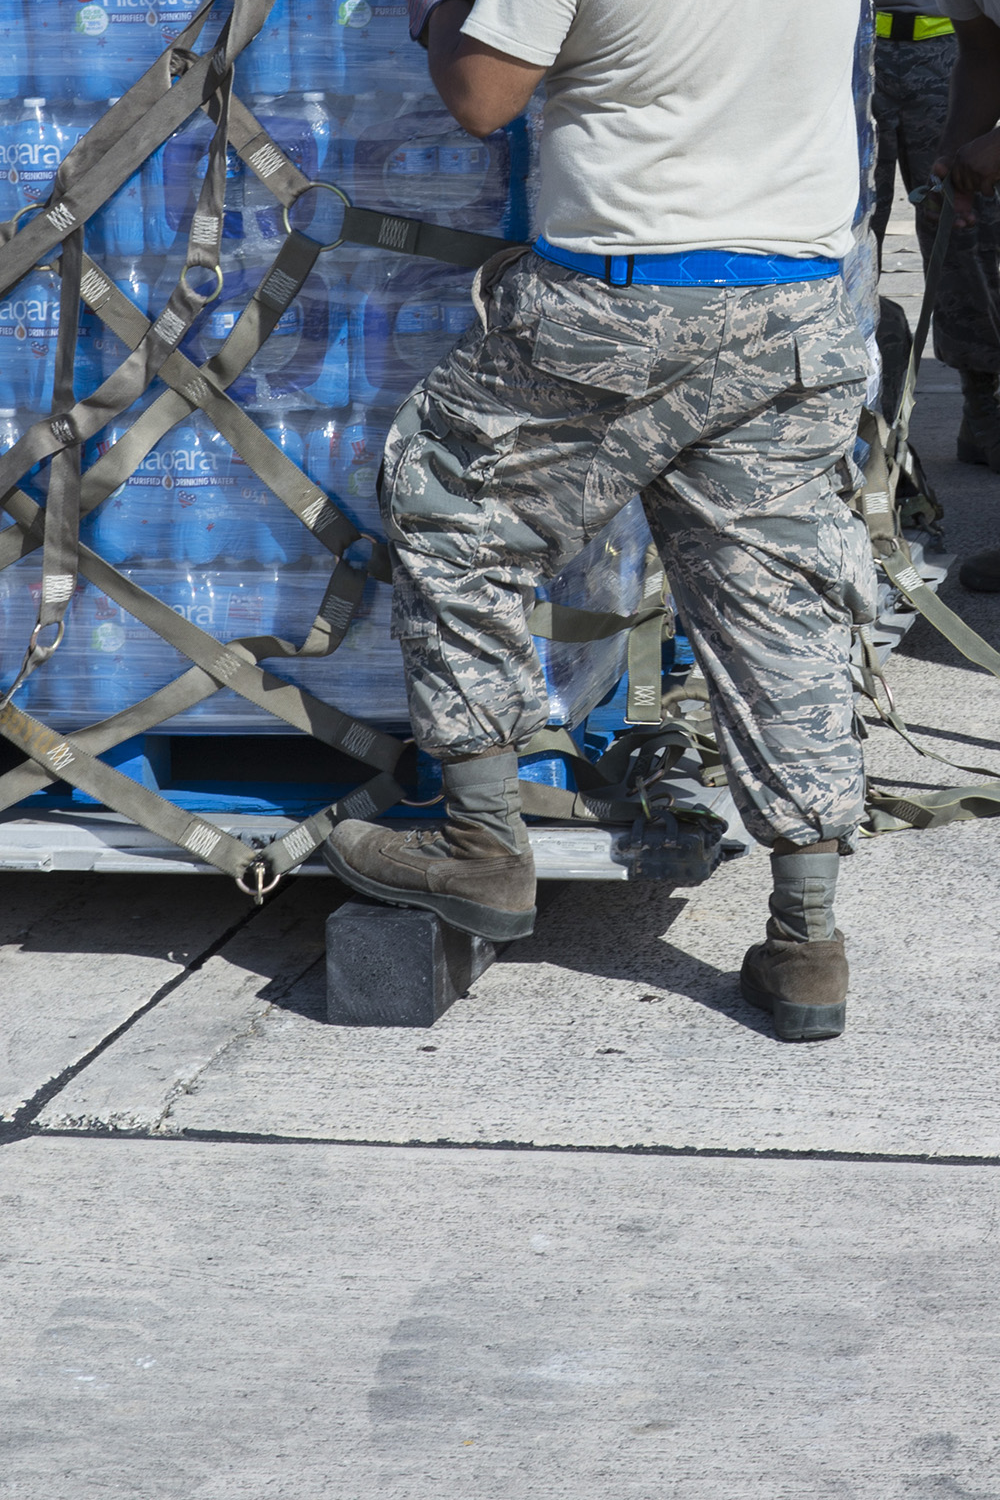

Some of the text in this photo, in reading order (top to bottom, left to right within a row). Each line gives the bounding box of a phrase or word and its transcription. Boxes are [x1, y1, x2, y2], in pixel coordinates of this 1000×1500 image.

[112, 14, 144, 22] PURIFIED
[20, 172, 53, 180] DRINKING
[176, 478, 208, 486] DRINKING
[210, 477, 234, 485] WATER
